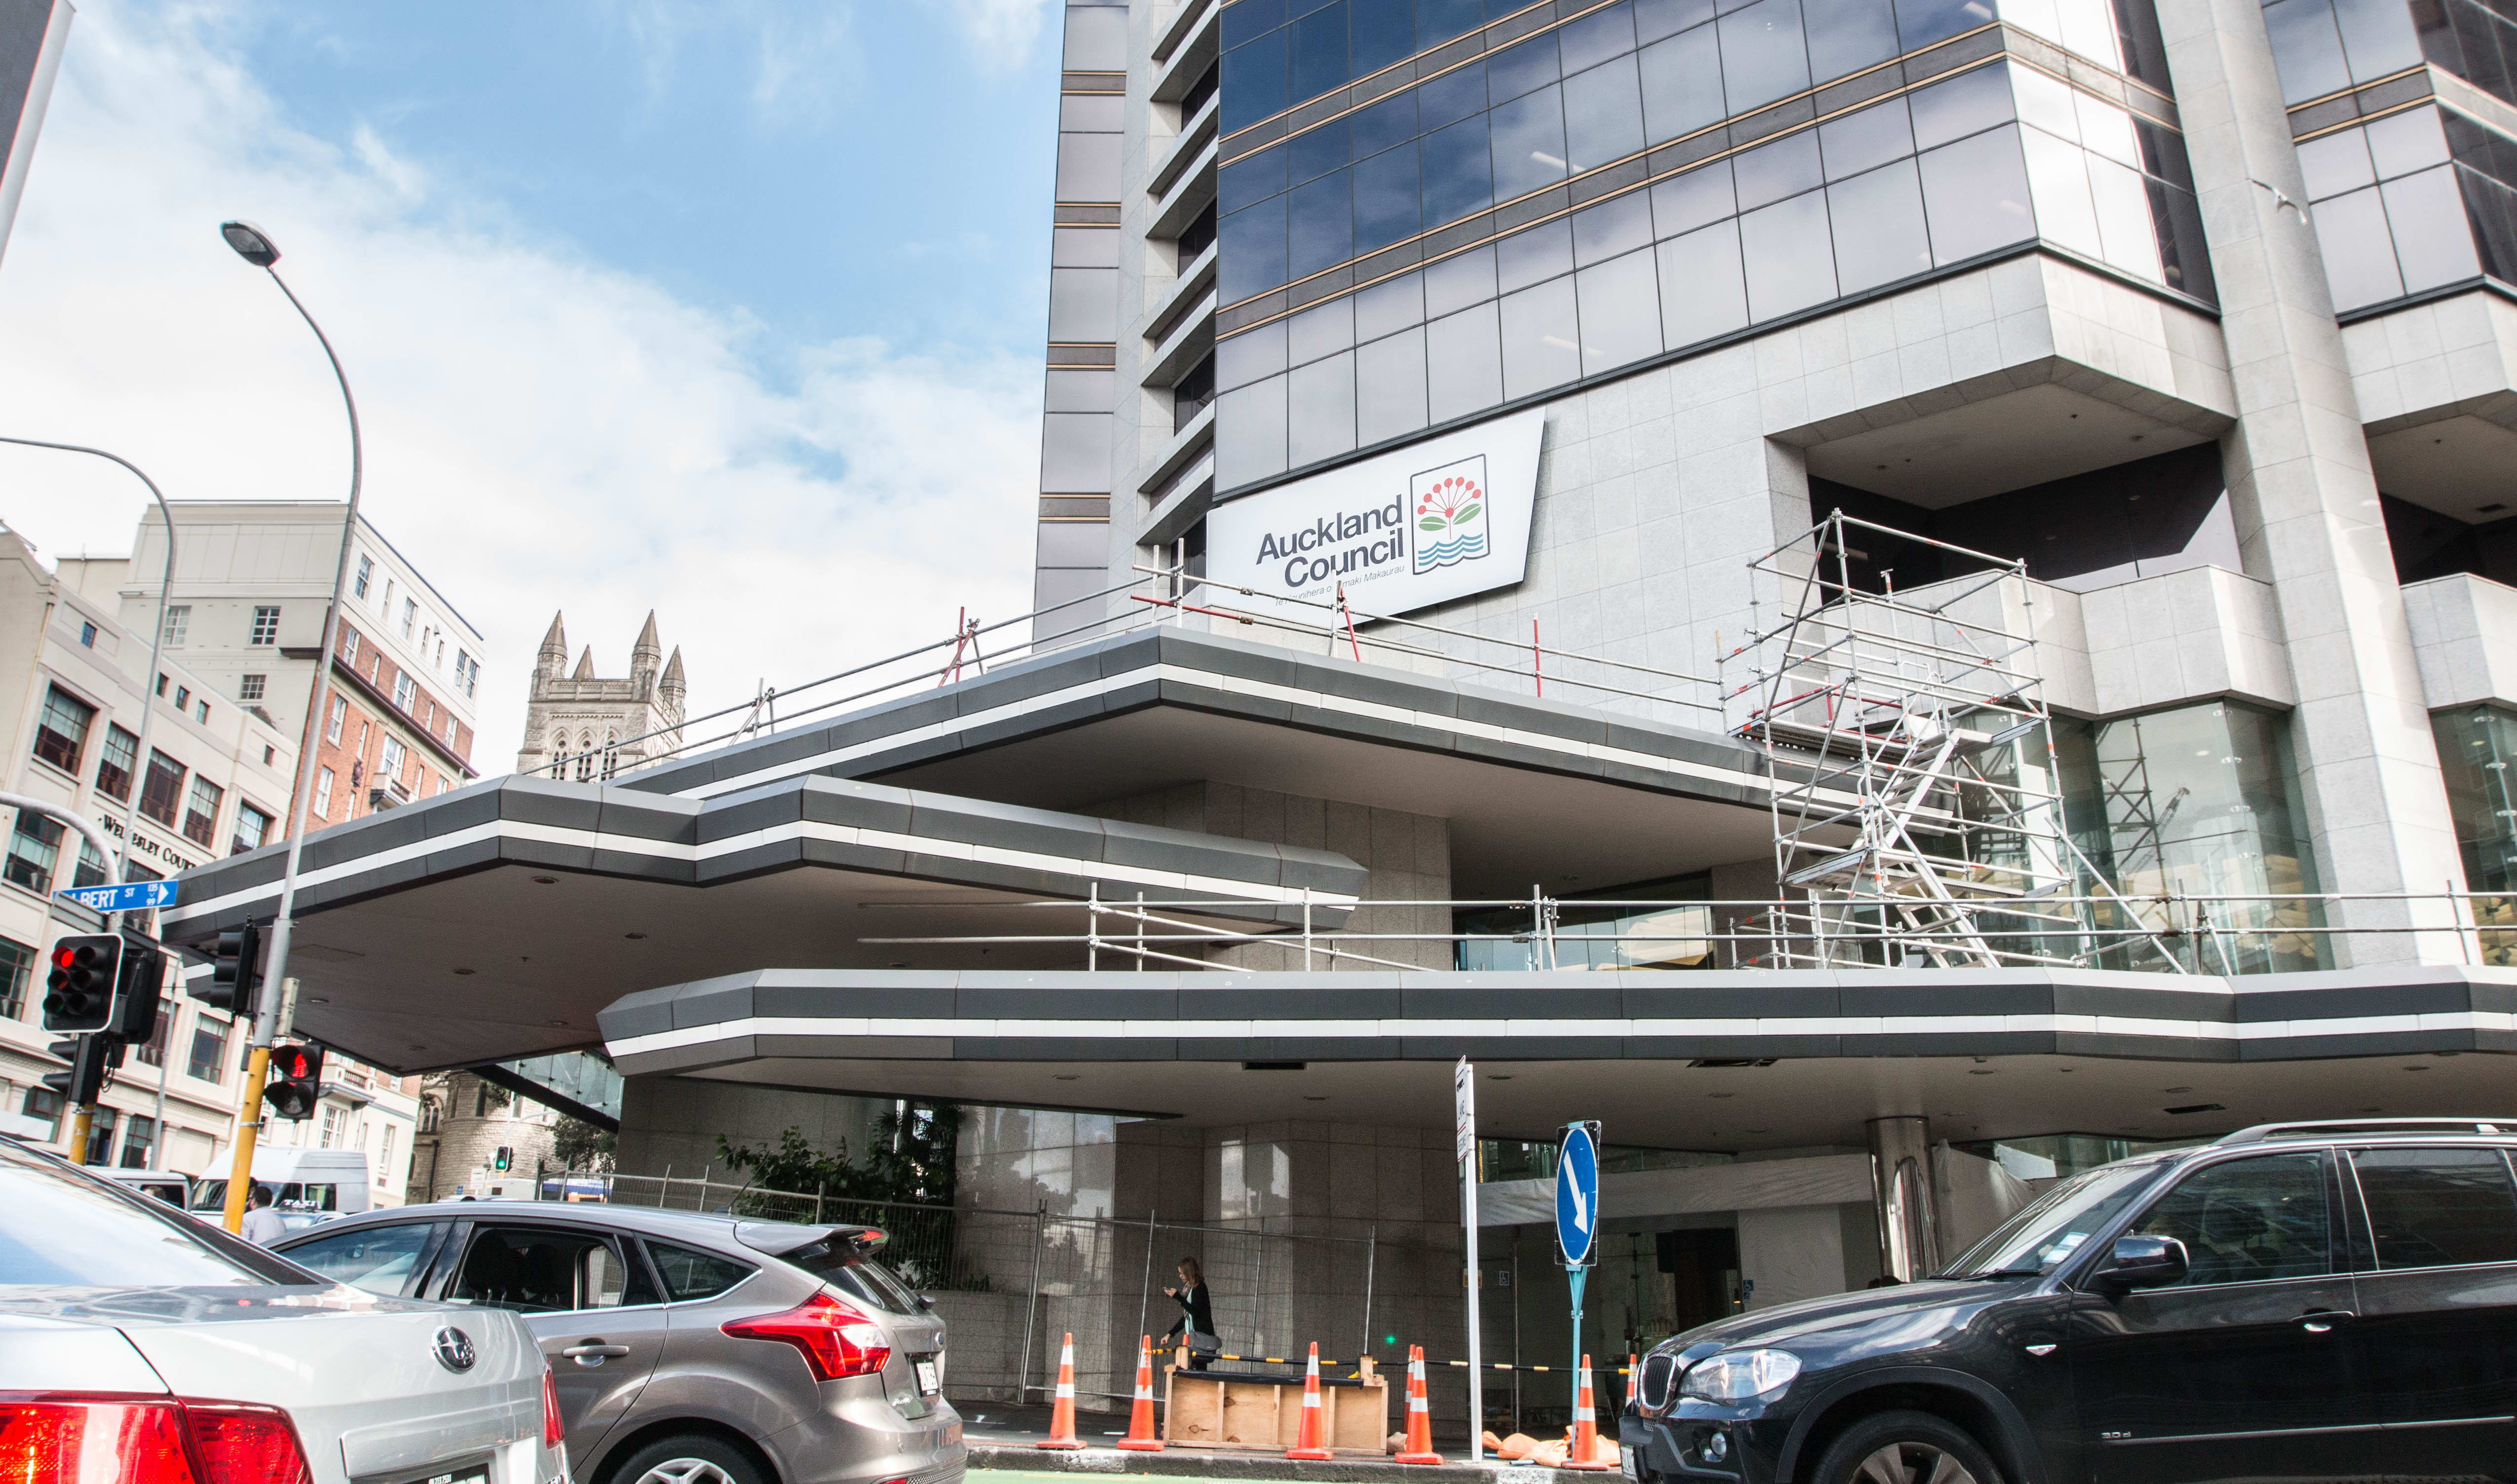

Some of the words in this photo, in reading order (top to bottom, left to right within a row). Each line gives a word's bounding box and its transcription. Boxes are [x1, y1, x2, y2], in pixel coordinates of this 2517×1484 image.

[1256, 494, 1403, 565] Auckland
[1285, 528, 1404, 587] Council
[1364, 565, 1405, 582] Makaurau
[104, 814, 160, 856] WELESLEY
[71, 889, 118, 908] BERT
[124, 888, 135, 898] ST
